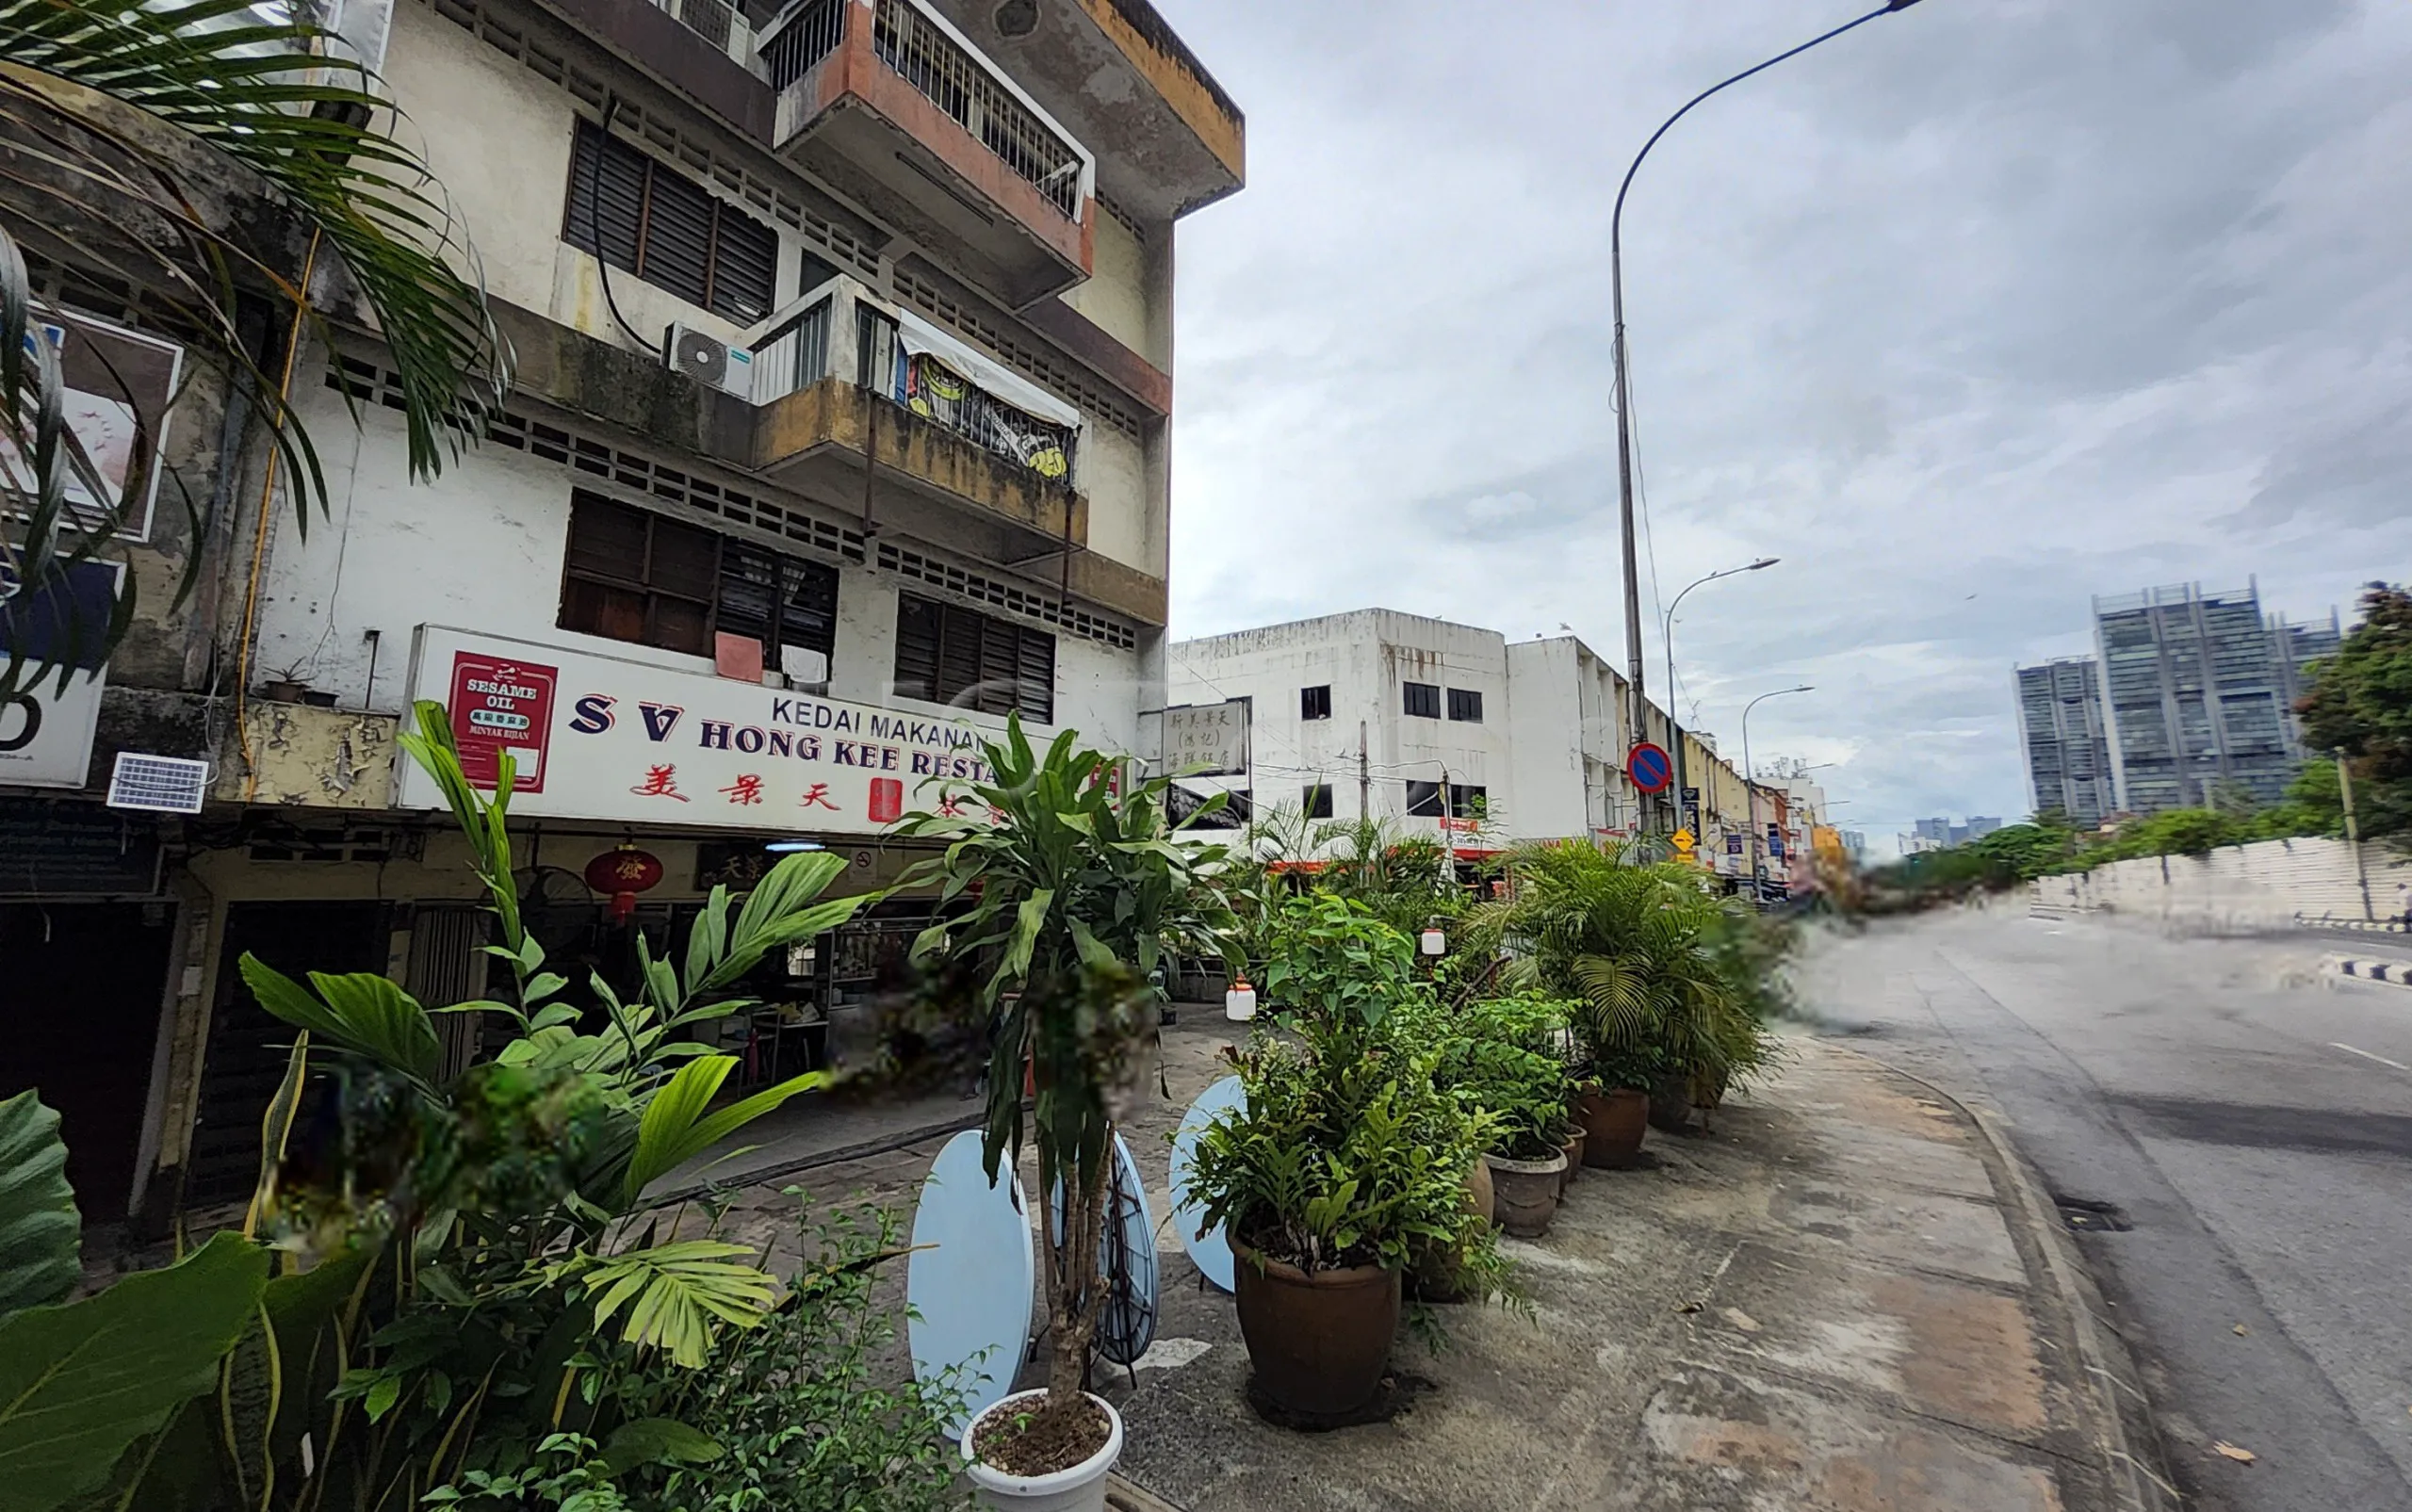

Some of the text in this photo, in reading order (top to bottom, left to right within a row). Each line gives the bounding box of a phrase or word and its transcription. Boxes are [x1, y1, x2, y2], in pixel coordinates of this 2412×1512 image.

[467, 678, 537, 700] SESAME
[486, 695, 515, 710] OIL
[772, 697, 860, 734] KEDAI
[468, 724, 503, 738] MINYAK
[568, 693, 997, 784] S V HONG KEE RESTA
